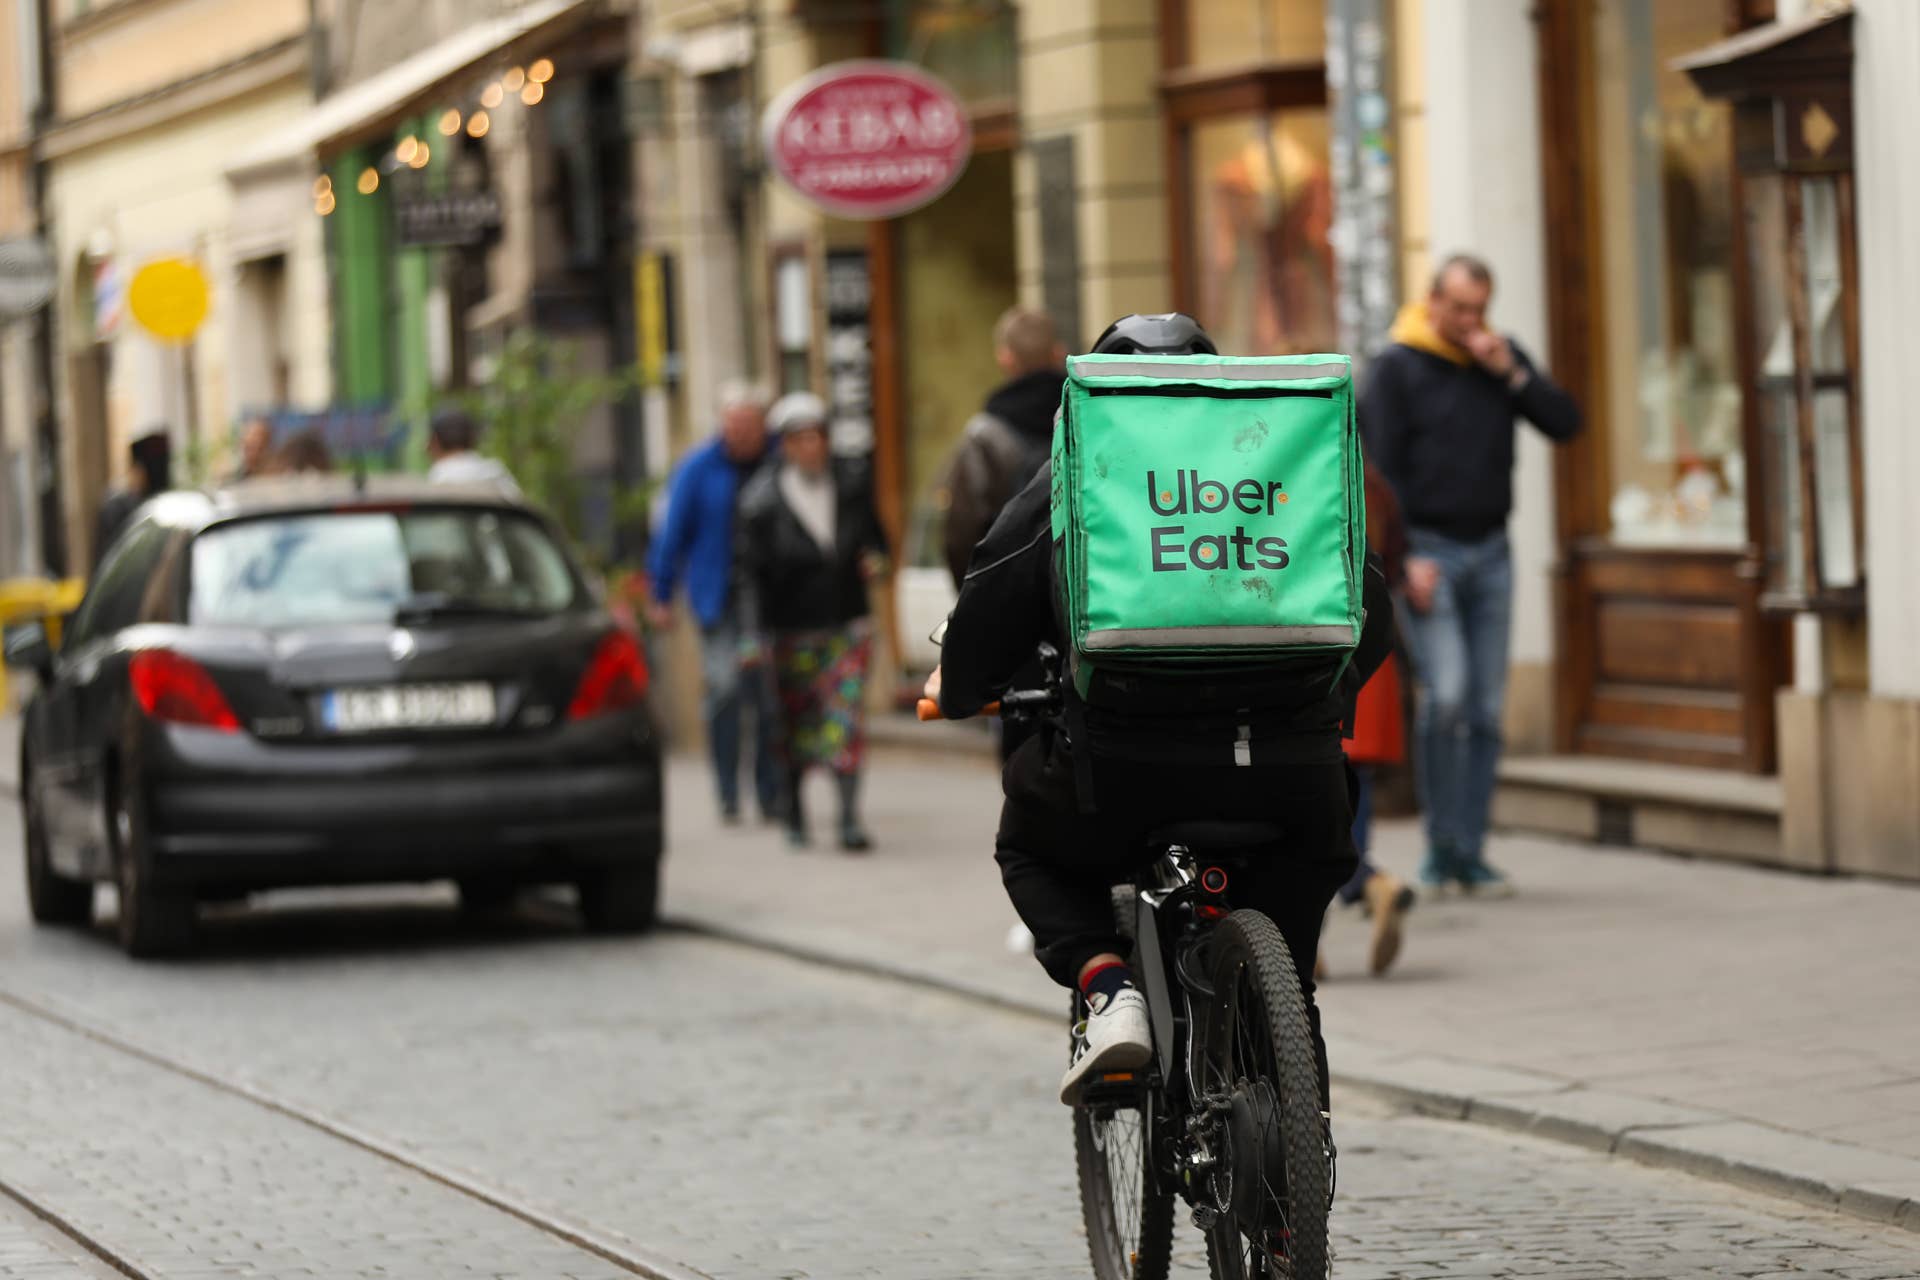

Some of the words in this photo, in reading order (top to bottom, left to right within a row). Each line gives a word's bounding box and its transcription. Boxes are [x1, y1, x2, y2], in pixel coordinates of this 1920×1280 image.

[785, 100, 960, 154] KEBAB
[1147, 469, 1282, 516] Uber
[1151, 526, 1289, 572] Eats
